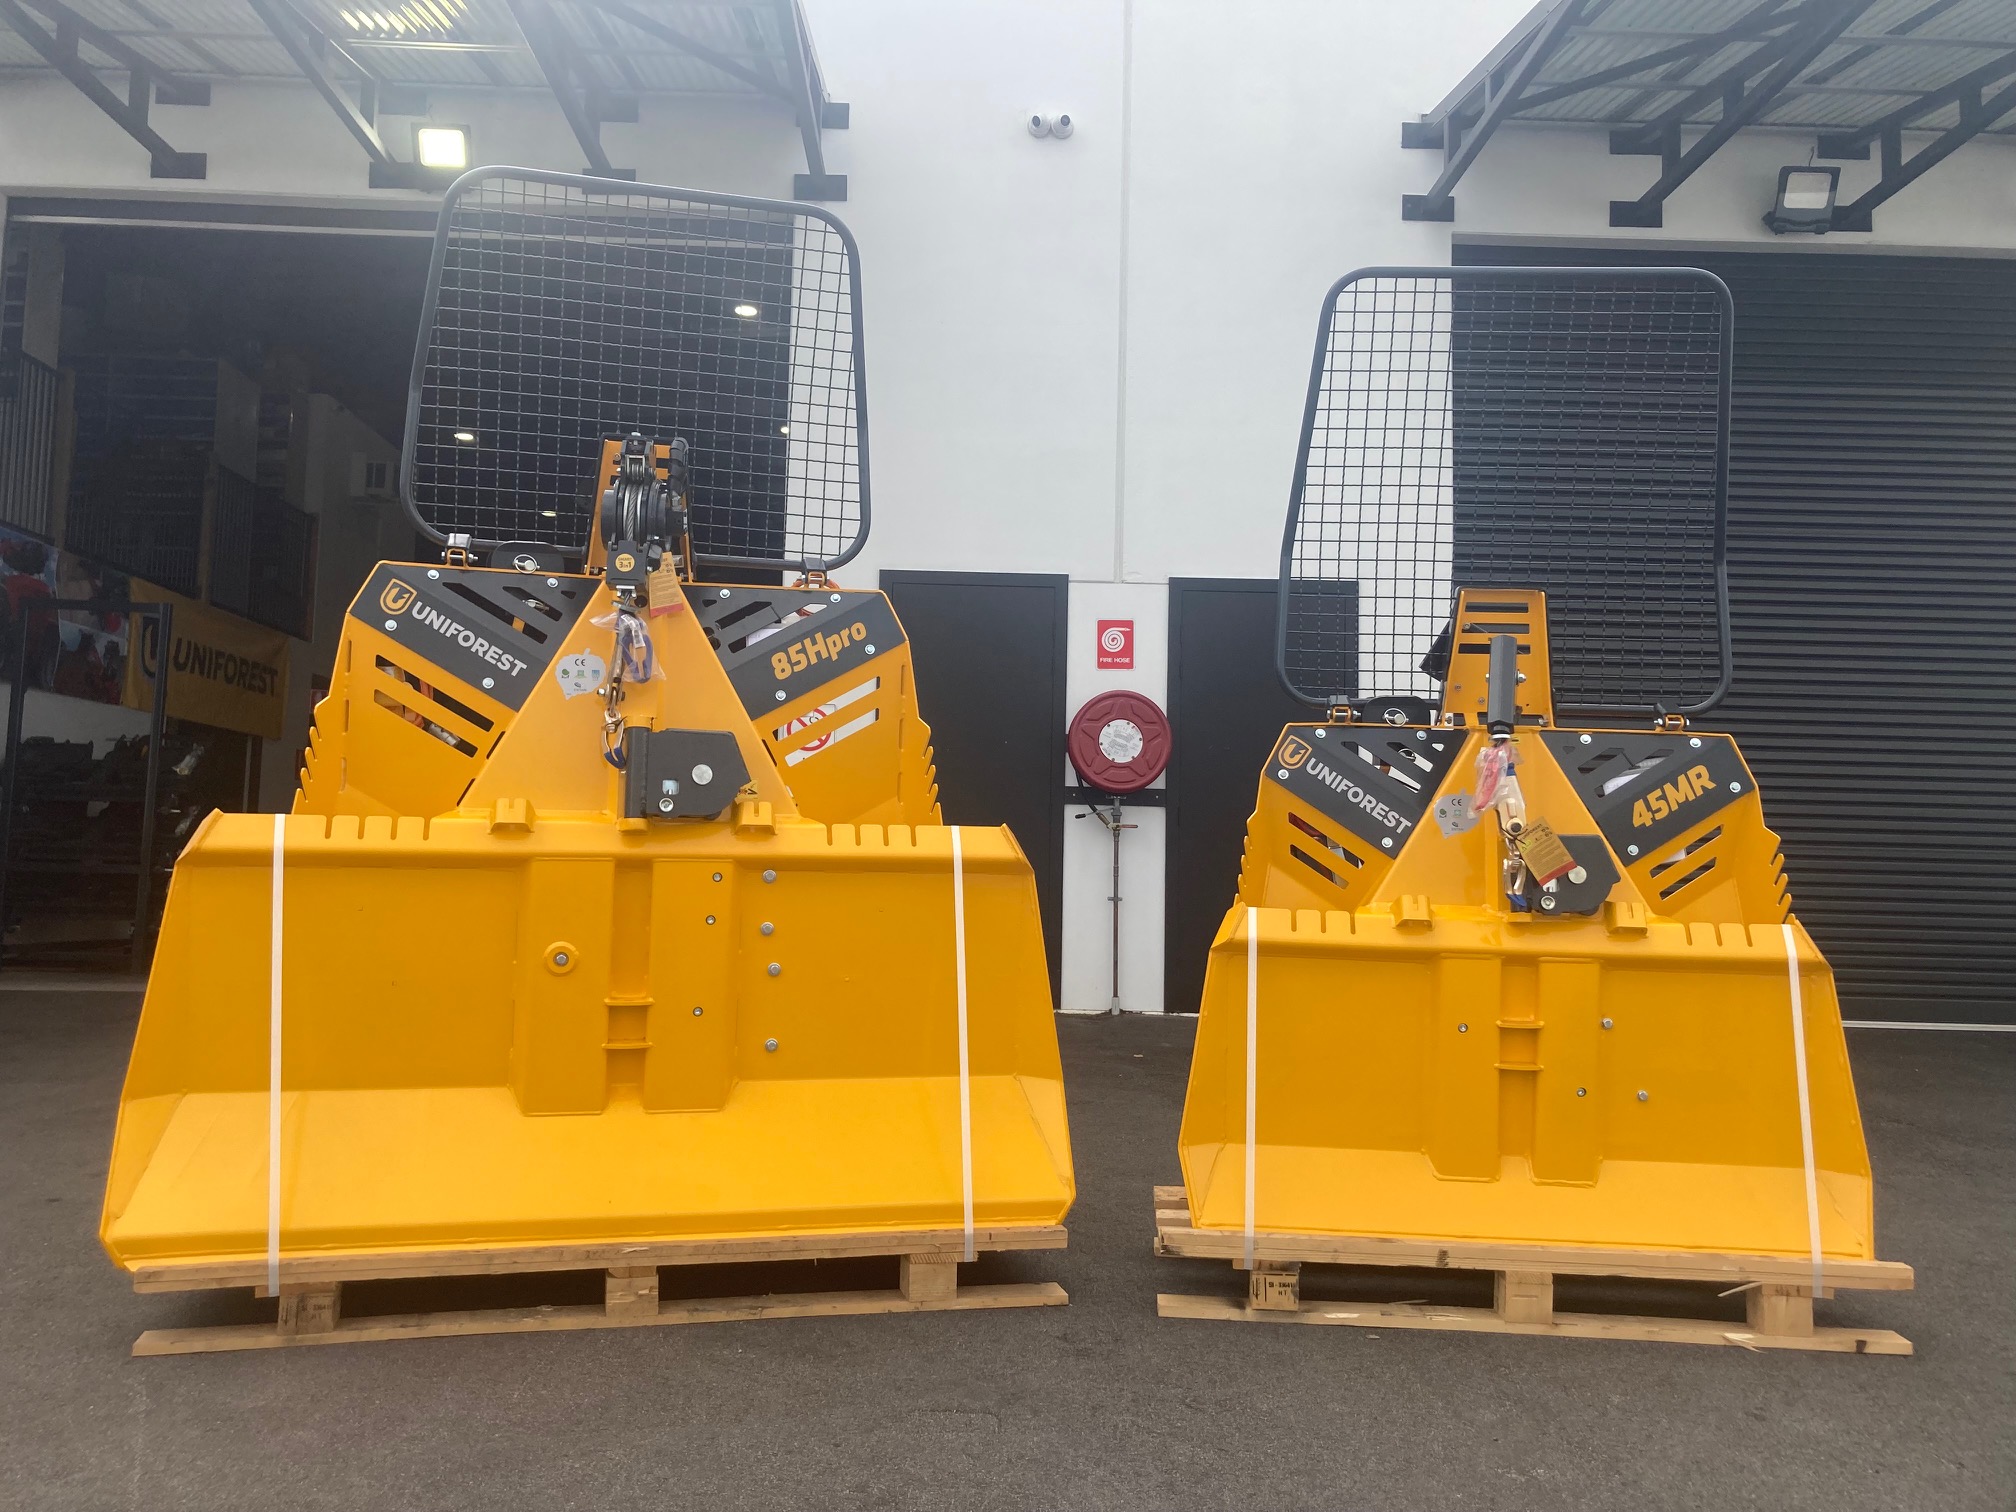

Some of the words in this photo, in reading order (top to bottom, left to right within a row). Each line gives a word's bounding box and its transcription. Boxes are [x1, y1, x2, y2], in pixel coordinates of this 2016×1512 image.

[172, 637, 278, 697] UNIFOREST
[412, 601, 527, 677] UNIFOREST
[574, 658, 586, 667] CE
[771, 622, 867, 680] 85Hpro
[1306, 757, 1412, 834] UNIFOREST
[1451, 798, 1462, 807] CE
[1632, 765, 1717, 828] 45MR
